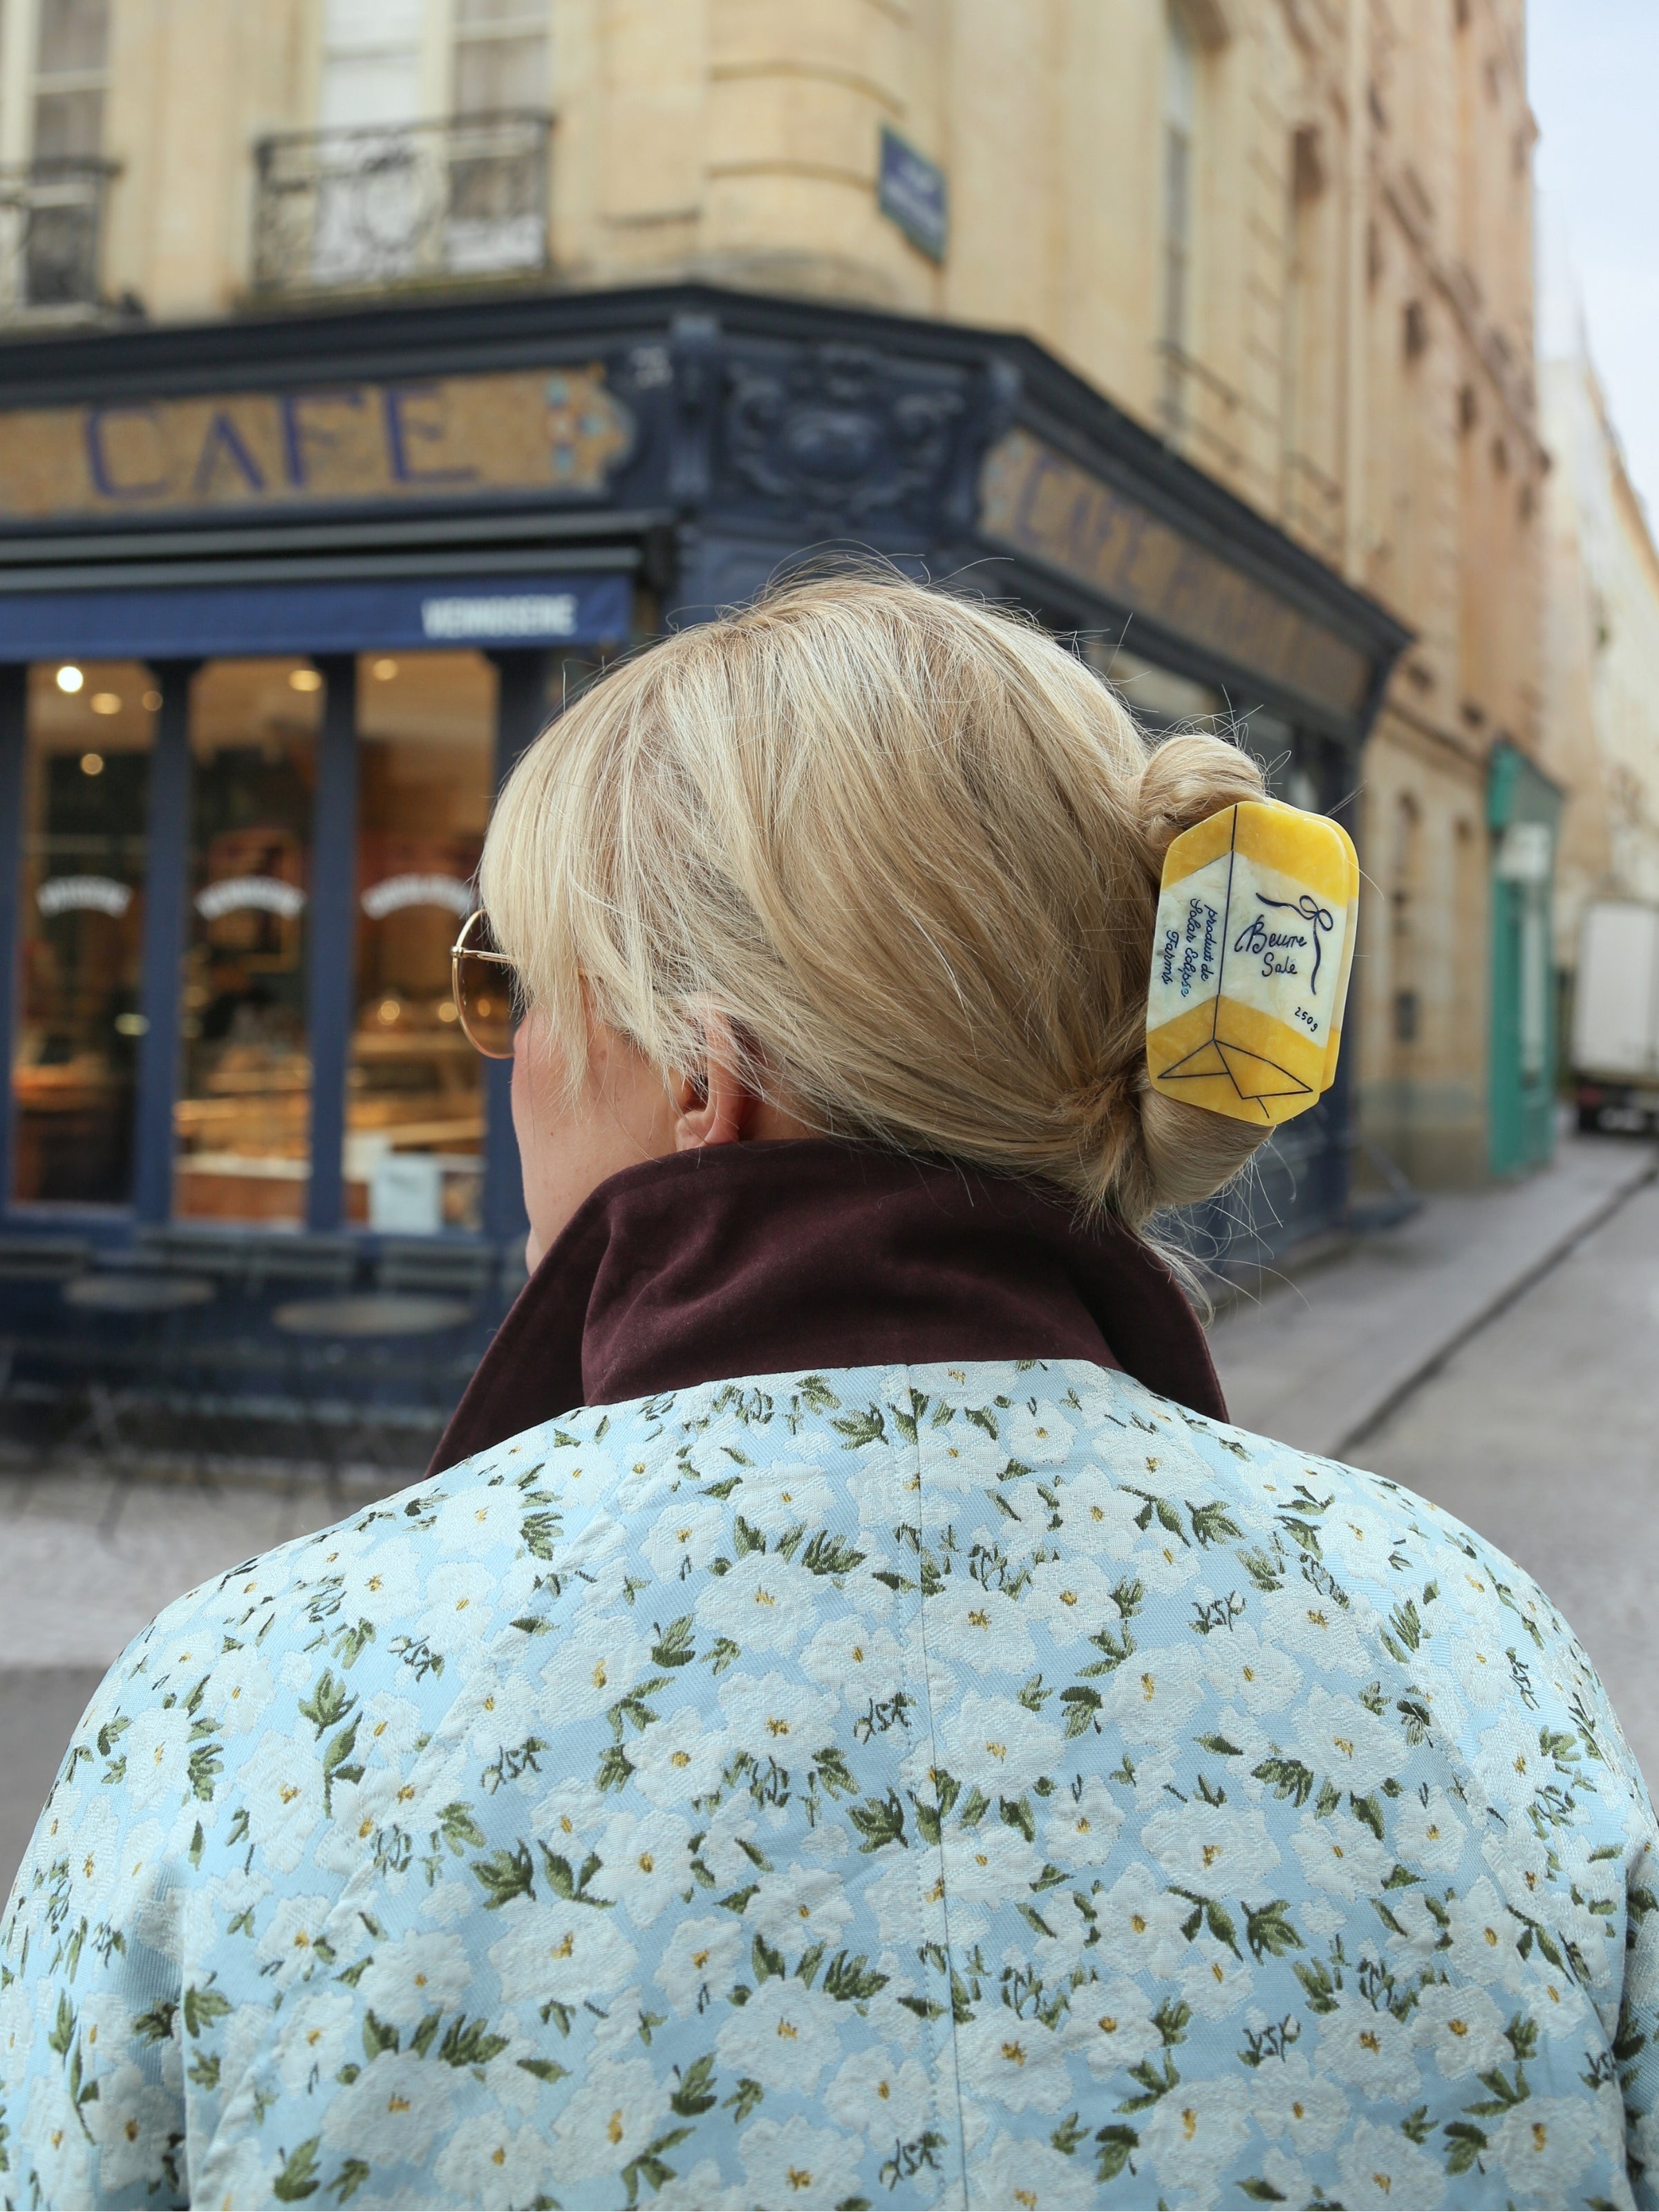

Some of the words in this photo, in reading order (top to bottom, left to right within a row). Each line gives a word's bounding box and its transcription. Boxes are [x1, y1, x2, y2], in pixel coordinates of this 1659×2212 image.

[1186, 898, 1203, 943] Solar
[1234, 914, 1307, 954] Beurre
[1161, 930, 1179, 984] Farms
[1178, 948, 1198, 997] Eclipse
[1201, 964, 1215, 982] de
